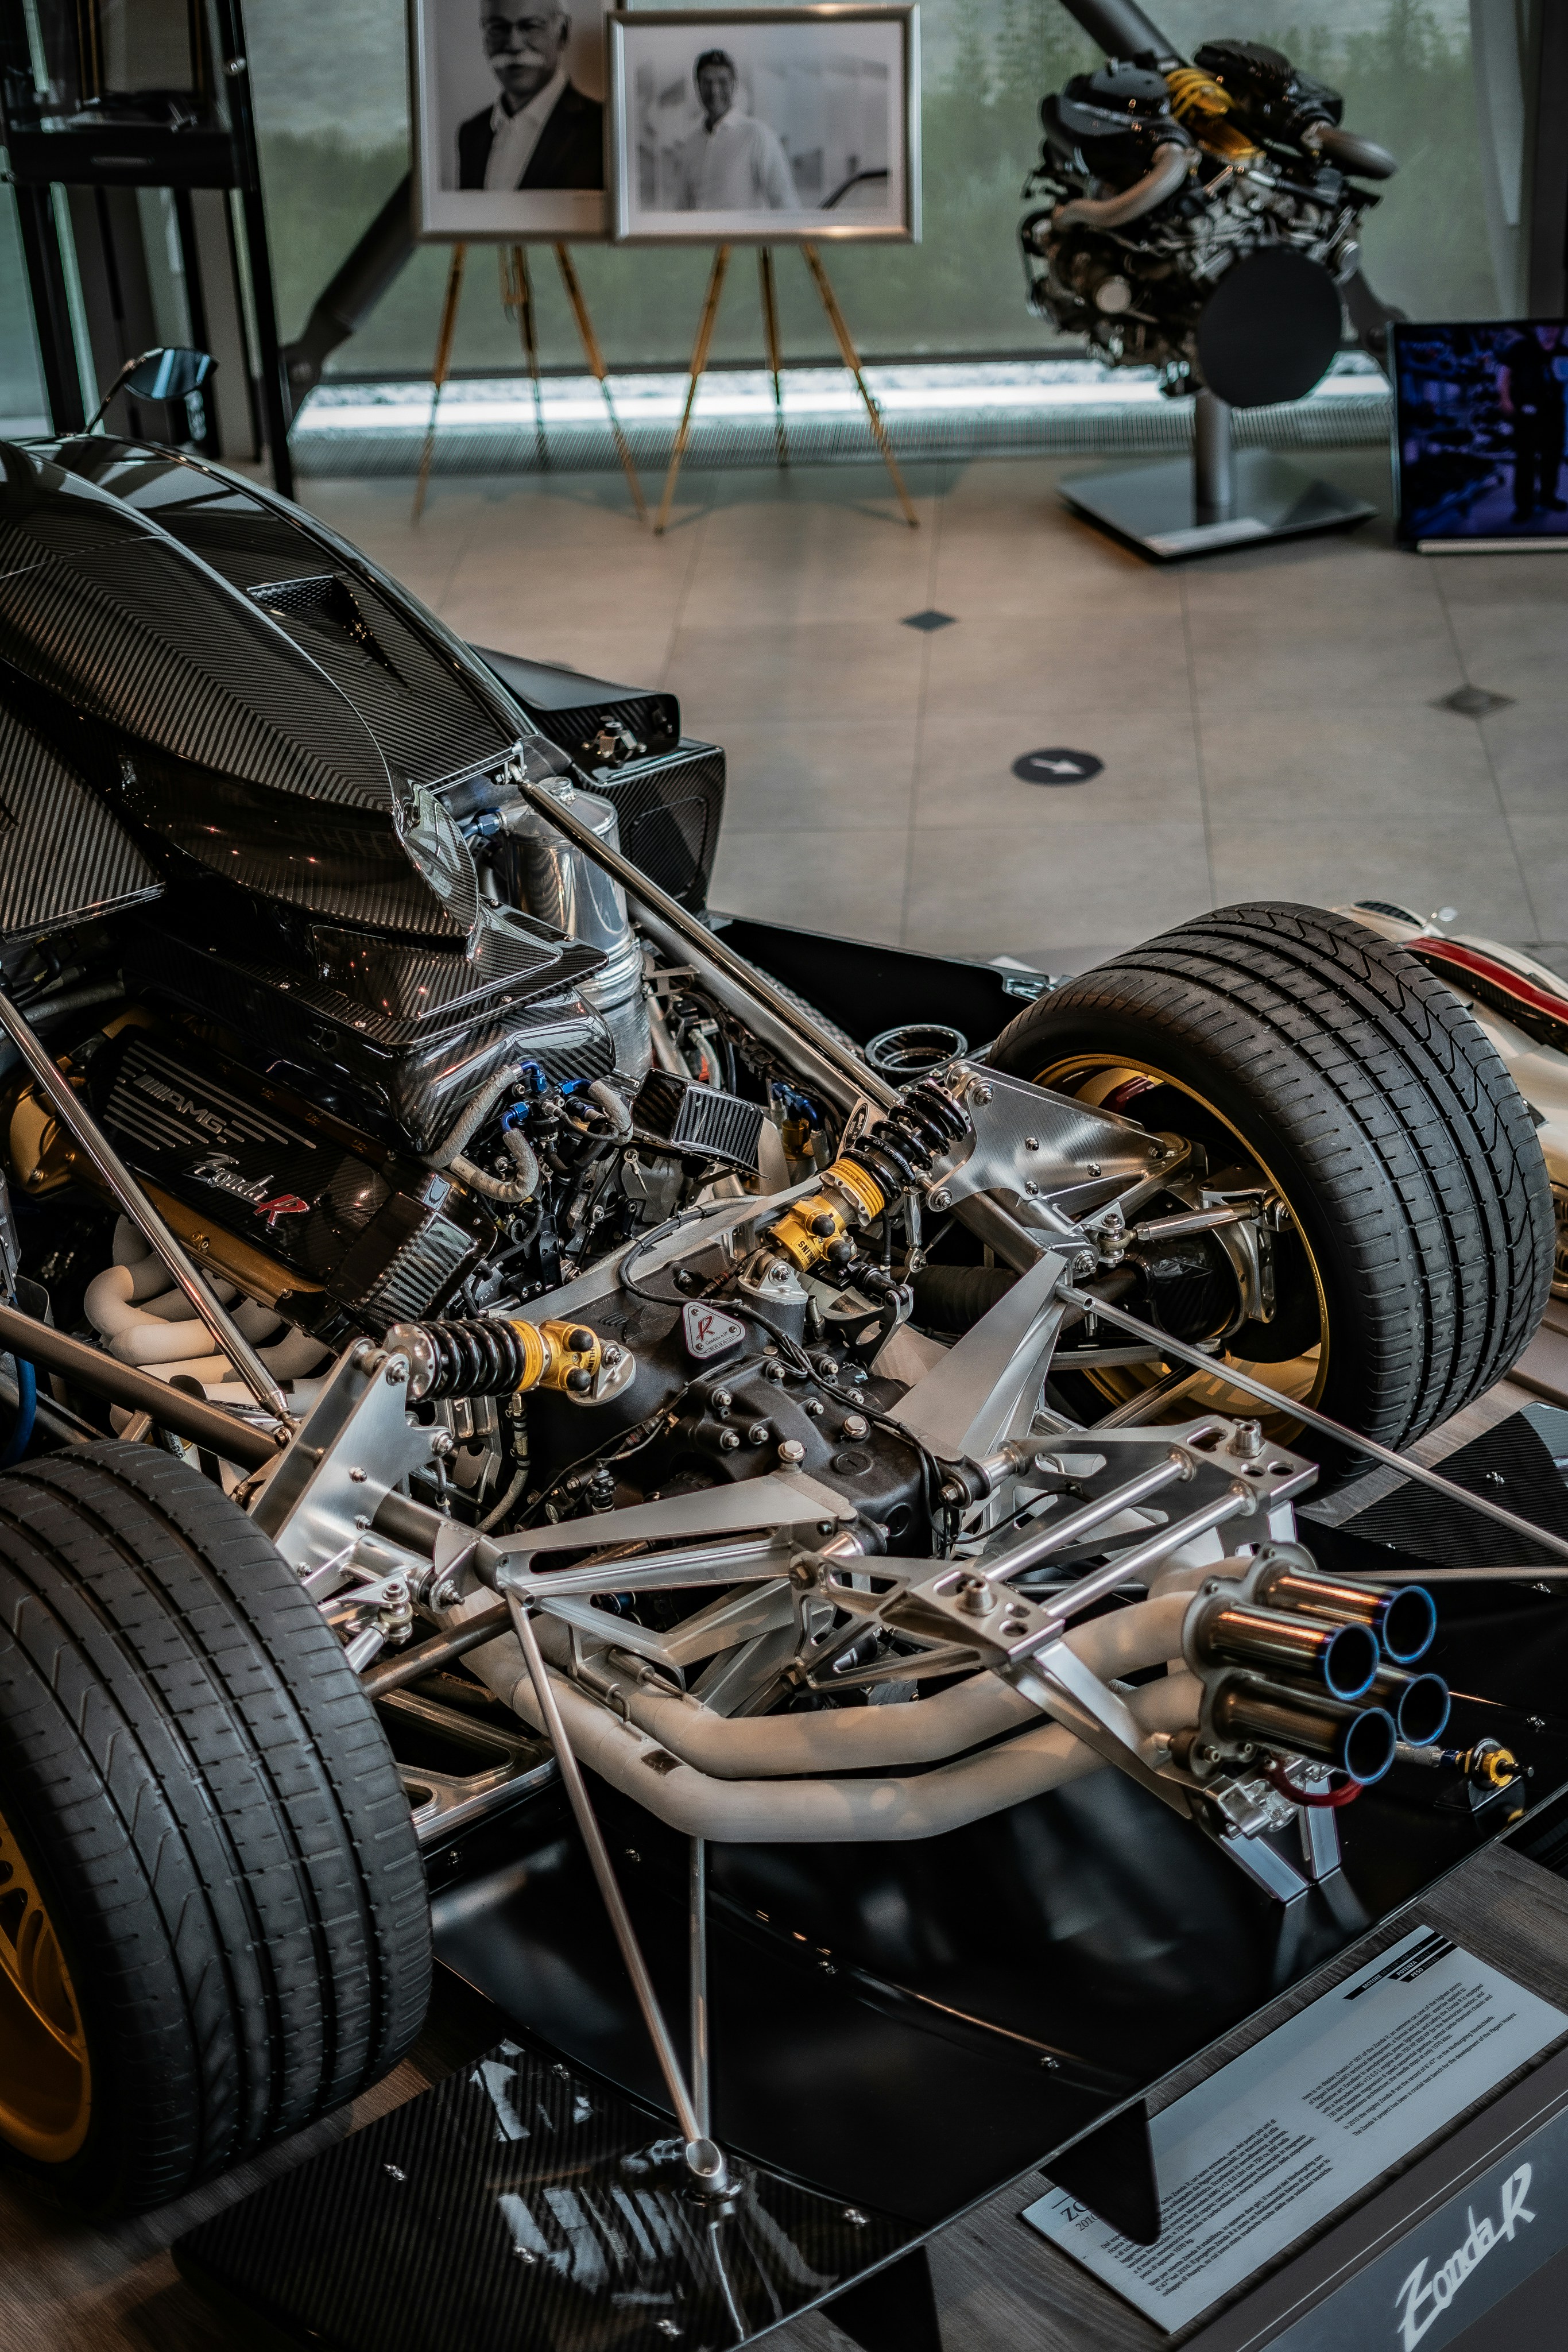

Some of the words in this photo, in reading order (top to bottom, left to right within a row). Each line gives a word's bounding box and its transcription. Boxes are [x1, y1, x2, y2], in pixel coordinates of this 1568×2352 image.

[165, 1091, 226, 1134] AMG
[181, 1152, 274, 1205] Zonda
[253, 1194, 310, 1227] R
[696, 1314, 715, 1342] R
[705, 1336, 721, 1345] Gearbox
[710, 1337, 734, 1351] PAGANI
[1361, 1974, 1383, 1989] MOTORE
[1395, 1960, 1418, 1976] POTENZA
[1410, 1967, 1424, 1978] PESO
[1301, 2091, 1314, 2100] Here
[1319, 2074, 1338, 2087] display
[1333, 2064, 1350, 2076] chassis
[1352, 2055, 1364, 2063] 007
[1371, 2037, 1387, 2048] Zonda
[1393, 2018, 1412, 2032] extreme
[1434, 1990, 1452, 2002] highest
[1447, 1981, 1463, 1993] points
[1314, 2091, 1338, 2110] automotive
[1342, 2073, 1362, 2088] Excellent
[1419, 2022, 1431, 2030] and
[1427, 2014, 1443, 2025] safety
[1445, 2001, 1460, 2011] Zonda
[1464, 1983, 1485, 1998] equipped
[1320, 2105, 1332, 2114] with
[1332, 2080, 1365, 2105] Mercedes-AMG
[1361, 2075, 1372, 2083] v12
[1379, 2058, 1396, 2071] engine
[1391, 2051, 1404, 2060] with
[1400, 2045, 1412, 2053] 750
[1414, 2035, 1426, 2043] 800
[1441, 2006, 1464, 2024] Revolucion
[1346, 2116, 1361, 2126] 2010
[1364, 2100, 1382, 2114] mighty
[1377, 2091, 1393, 2103] Zonda
[1399, 2079, 1410, 2087] the
[1406, 2069, 1422, 2082] record
[1447, 2032, 1473, 2051] Nurburgring
[1352, 2129, 1363, 2137] The
[1359, 2119, 1375, 2131] Zonda
[1375, 2106, 1393, 2119] project
[1388, 2100, 1399, 2109] has
[1396, 2093, 1410, 2103] been
[1409, 2081, 1425, 2093] crucial
[1422, 2075, 1433, 2083] test
[1429, 2067, 1445, 2078] bench
[1453, 2039, 1481, 2060] development
[1488, 2021, 1505, 2034] Pagani
[1125, 2252, 1148, 2269] versione
[1174, 2223, 1187, 2233] 730
[1183, 2216, 1195, 2226] Nm
[1213, 2188, 1233, 2203] cambio
[1229, 2169, 1259, 2192] sequenziale
[1255, 2152, 1281, 2172] trasversale
[1283, 2133, 1307, 2152] magnesio
[1147, 2276, 1160, 2287] Non
[1158, 2270, 1170, 2280] per
[1166, 2258, 1184, 2273] niente
[1180, 2247, 1198, 2261] Zonda
[1227, 2212, 1247, 2228] appena
[1242, 2205, 1255, 2214] due
[1264, 2184, 1282, 2198] record
[1279, 2179, 1290, 2187] del
[1286, 2159, 1317, 2182] Nurburgring
[1313, 2154, 1323, 2162] con
[1156, 2234, 1186, 2257] monoscocca
[1182, 2220, 1203, 2236] centrale
[1205, 2195, 1237, 2219] carbo-titanio
[1238, 2183, 1255, 2195] nuova
[1251, 2163, 1280, 2184] architettura
[1276, 2154, 1291, 2165] delle
[1139, 2269, 1153, 2280] peso
[1156, 2252, 1176, 2267] appena
[1172, 2242, 1187, 2253] 1070
[1395, 2204, 1496, 2352] Zonda
[1499, 2163, 1536, 2242] R
